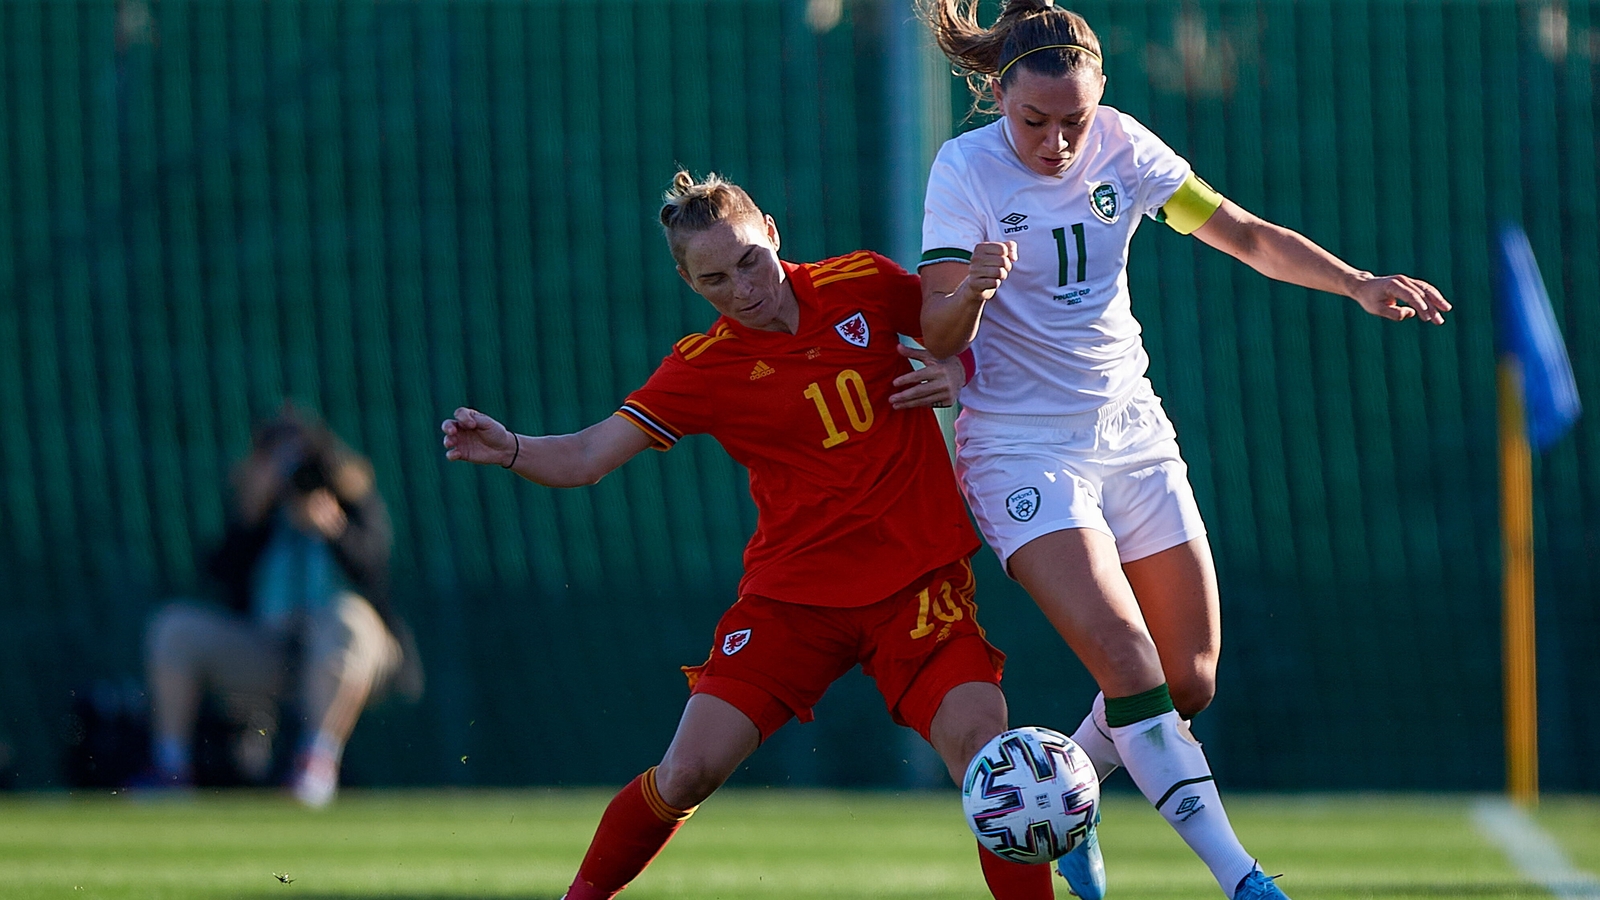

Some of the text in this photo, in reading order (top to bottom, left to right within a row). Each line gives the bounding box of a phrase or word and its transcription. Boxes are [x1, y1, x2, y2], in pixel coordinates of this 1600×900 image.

[1004, 225, 1028, 233] umbro
[1052, 223, 1087, 287] 11
[1079, 288, 1091, 296] CUP
[750, 367, 775, 380] adidas
[803, 369, 874, 449] 10
[1011, 490, 1033, 502] Ireland
[910, 581, 963, 639] 10
